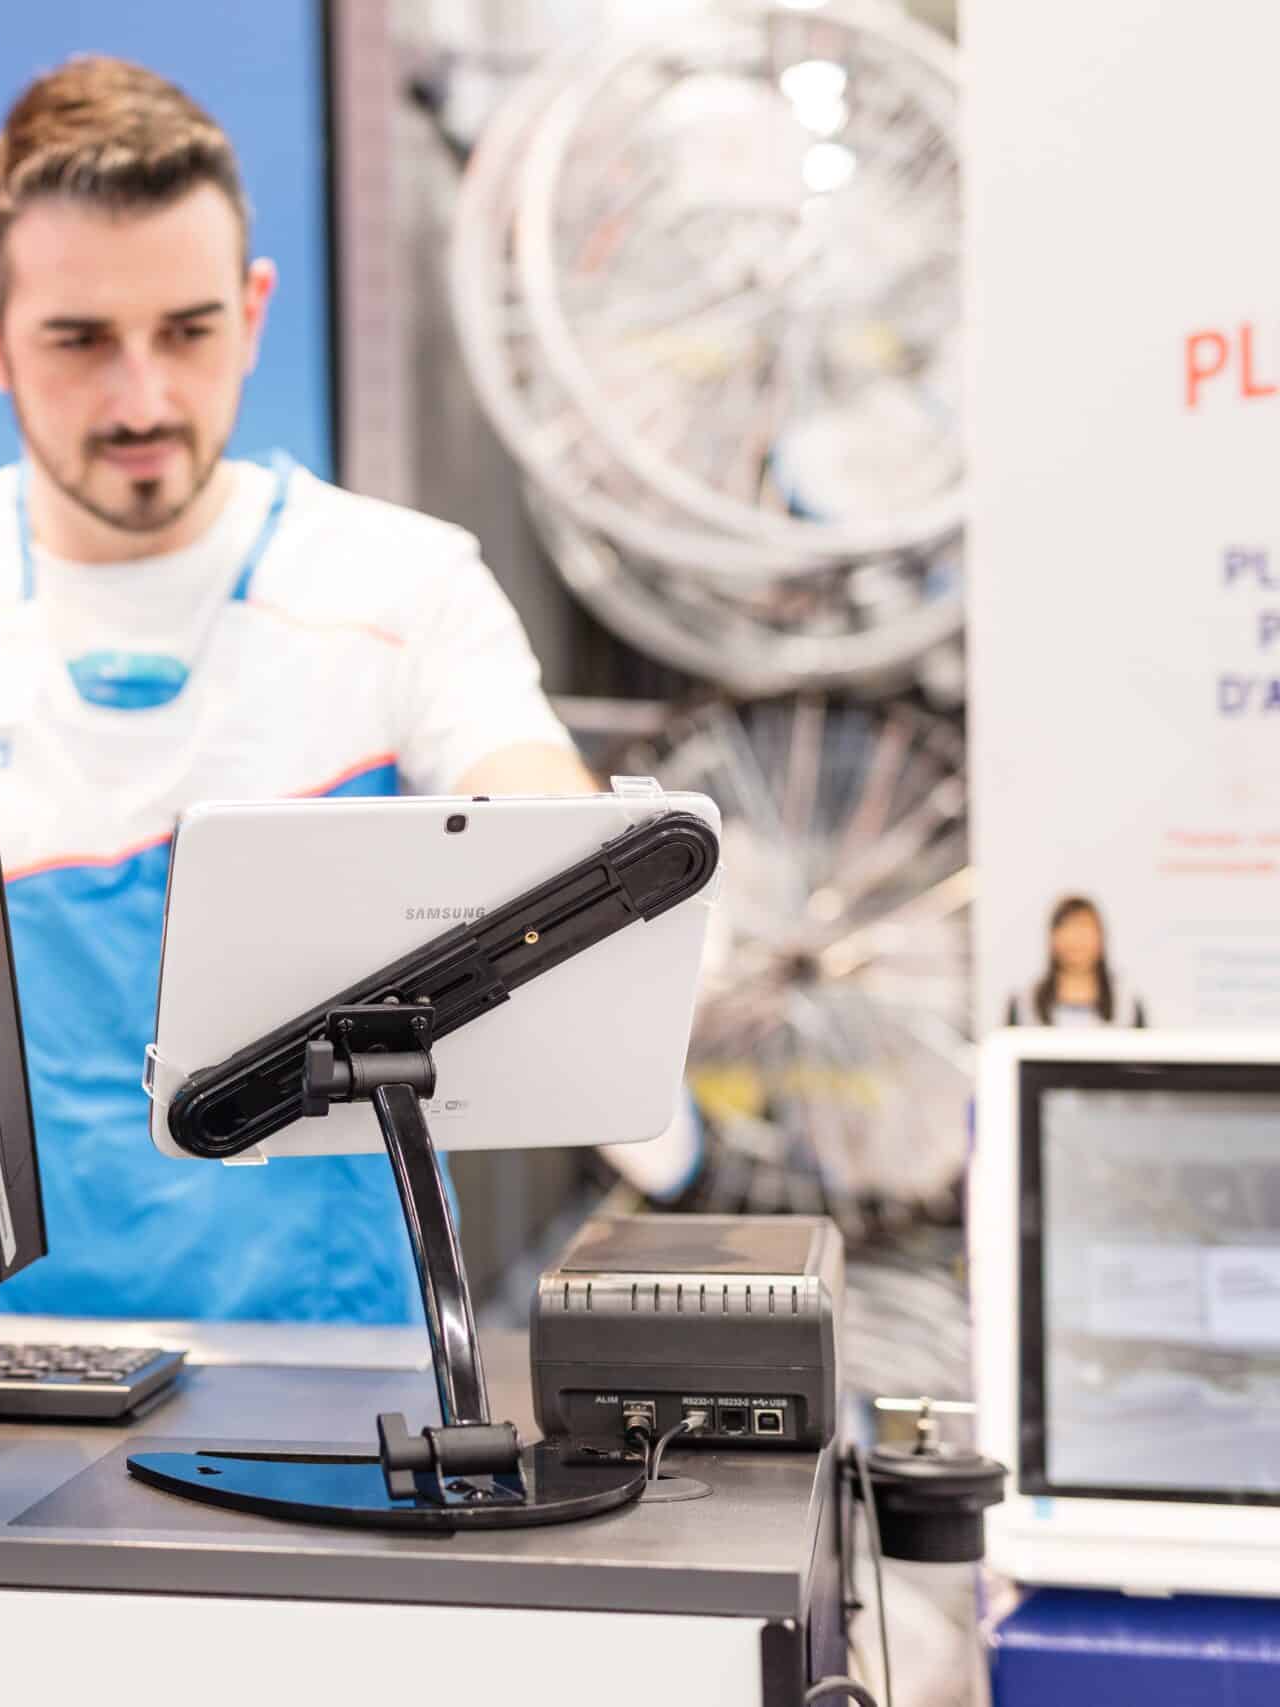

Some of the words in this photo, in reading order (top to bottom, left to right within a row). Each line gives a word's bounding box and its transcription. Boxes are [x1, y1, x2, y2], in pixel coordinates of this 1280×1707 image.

[1185, 321, 1279, 408] PL
[405, 907, 486, 921] SAMSUNG
[769, 1399, 788, 1408] USB
